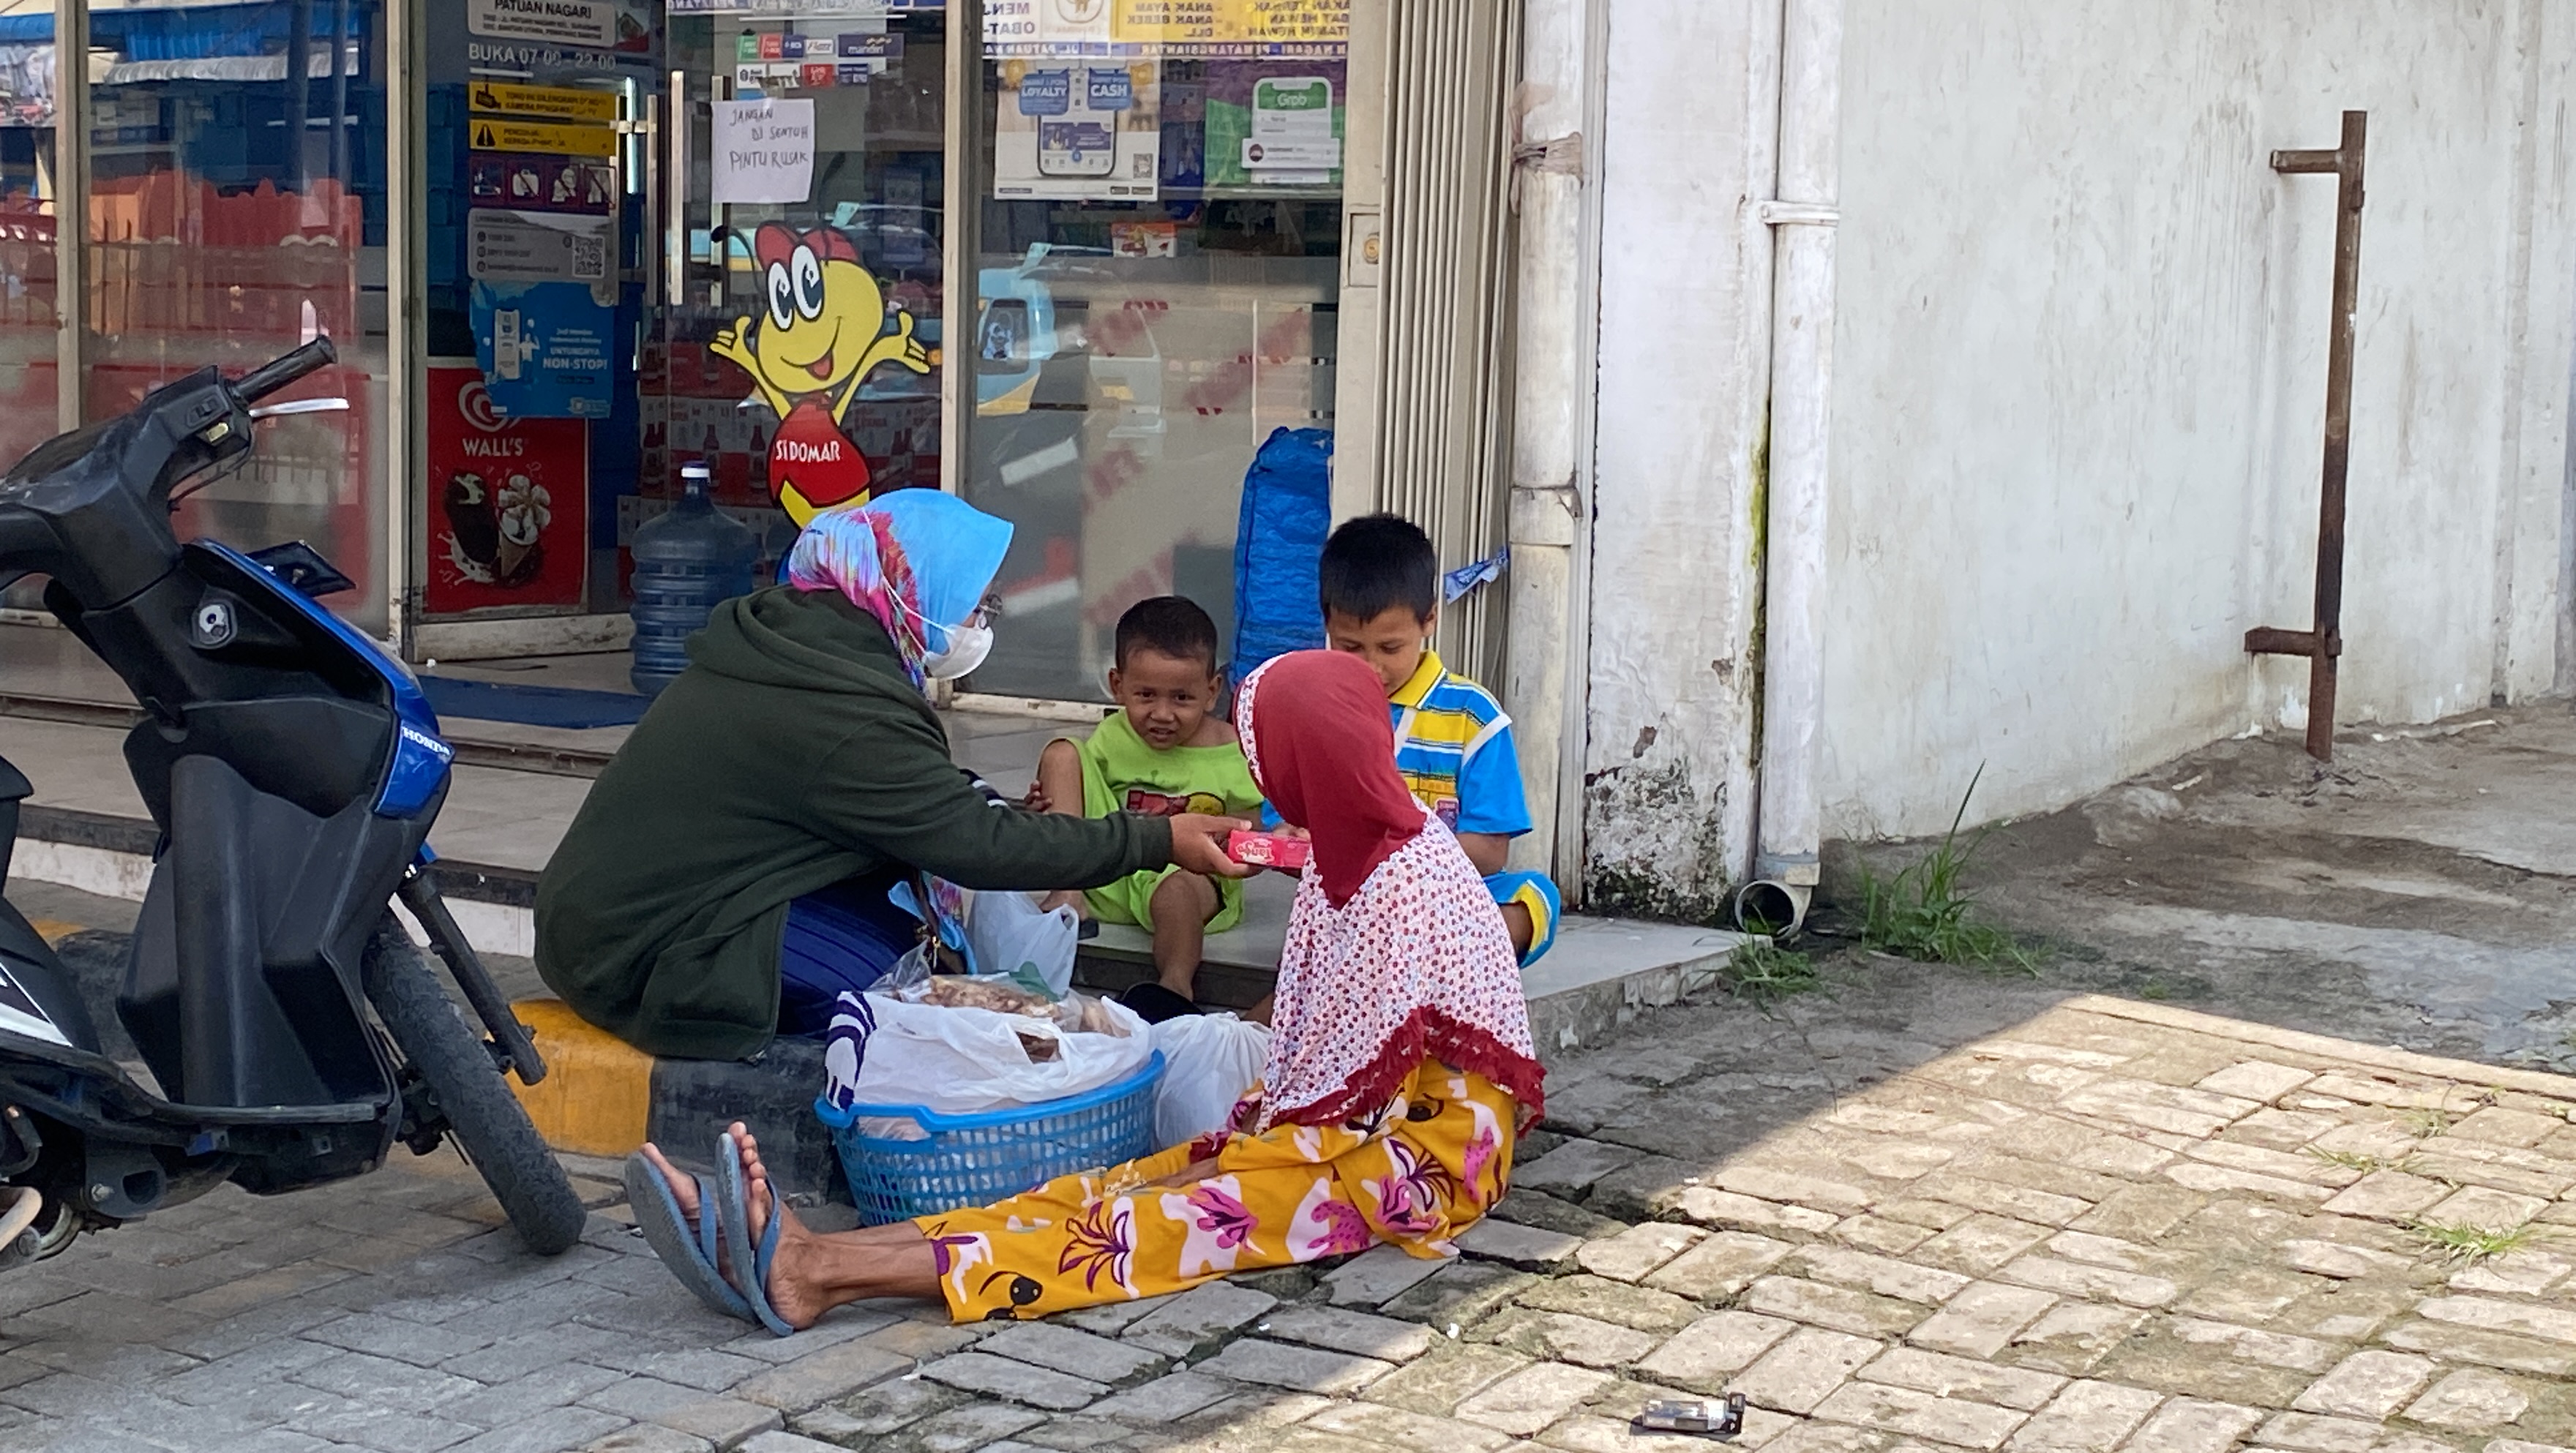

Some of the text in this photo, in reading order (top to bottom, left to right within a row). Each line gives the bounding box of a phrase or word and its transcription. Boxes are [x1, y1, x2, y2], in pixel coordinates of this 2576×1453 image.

[495, 0, 591, 19] PATUAN NAGARI
[469, 43, 515, 63] BUKA
[518, 48, 562, 67] 0700
[1021, 87, 1067, 97] LOYALTY
[1090, 83, 1128, 97] CASH
[1277, 92, 1308, 107] Grab
[730, 108, 774, 127] JANGAN
[769, 125, 809, 140] SENTUH
[730, 151, 809, 173] PINTU RUSAK
[542, 357, 608, 370] NON-STOP!
[463, 438, 524, 457] WALL'S
[401, 725, 451, 756] HONDA
[1237, 841, 1271, 860] Tango
